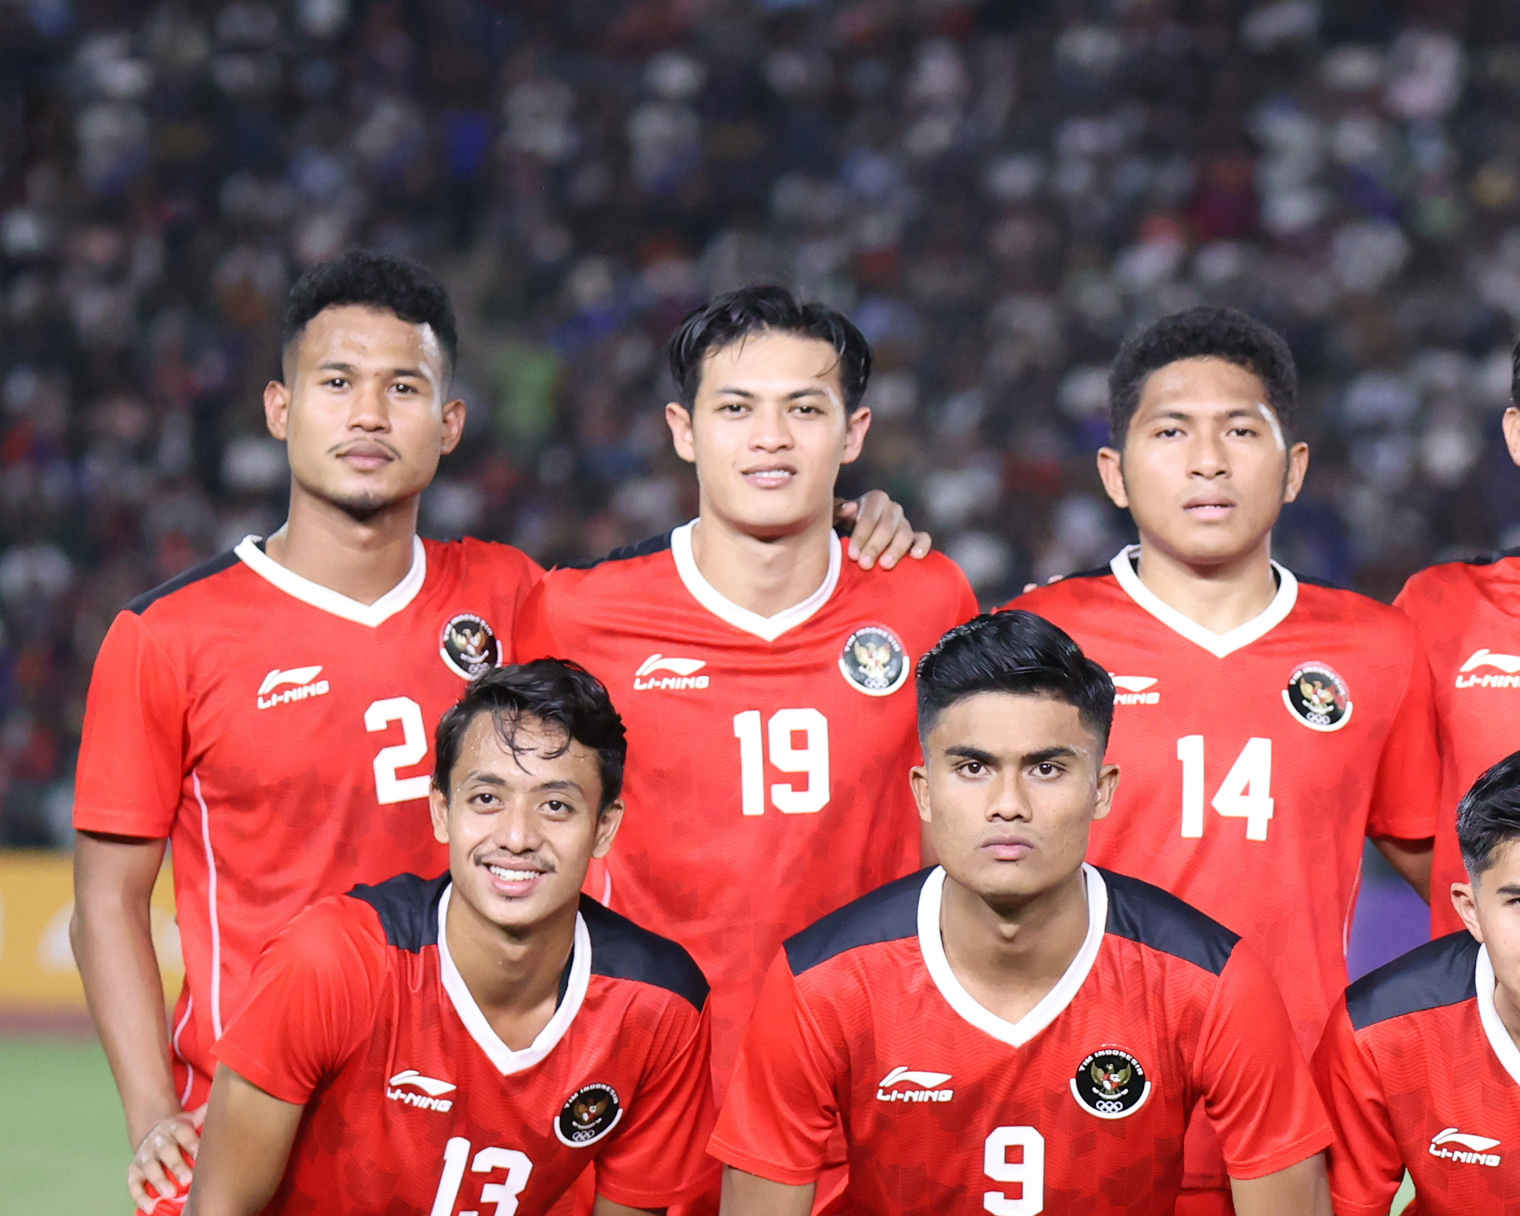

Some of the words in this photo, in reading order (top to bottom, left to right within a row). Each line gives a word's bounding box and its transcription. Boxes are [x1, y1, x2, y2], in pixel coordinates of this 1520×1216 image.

[257, 680, 330, 710] LI-NING
[633, 675, 710, 691] LI-NING
[364, 697, 431, 805] 2
[732, 708, 831, 815] 19
[1176, 734, 1275, 842] 14
[386, 1086, 453, 1113] LI-NING
[876, 1089, 954, 1102] LI-NING
[1428, 1143, 1502, 1168] LI-NING
